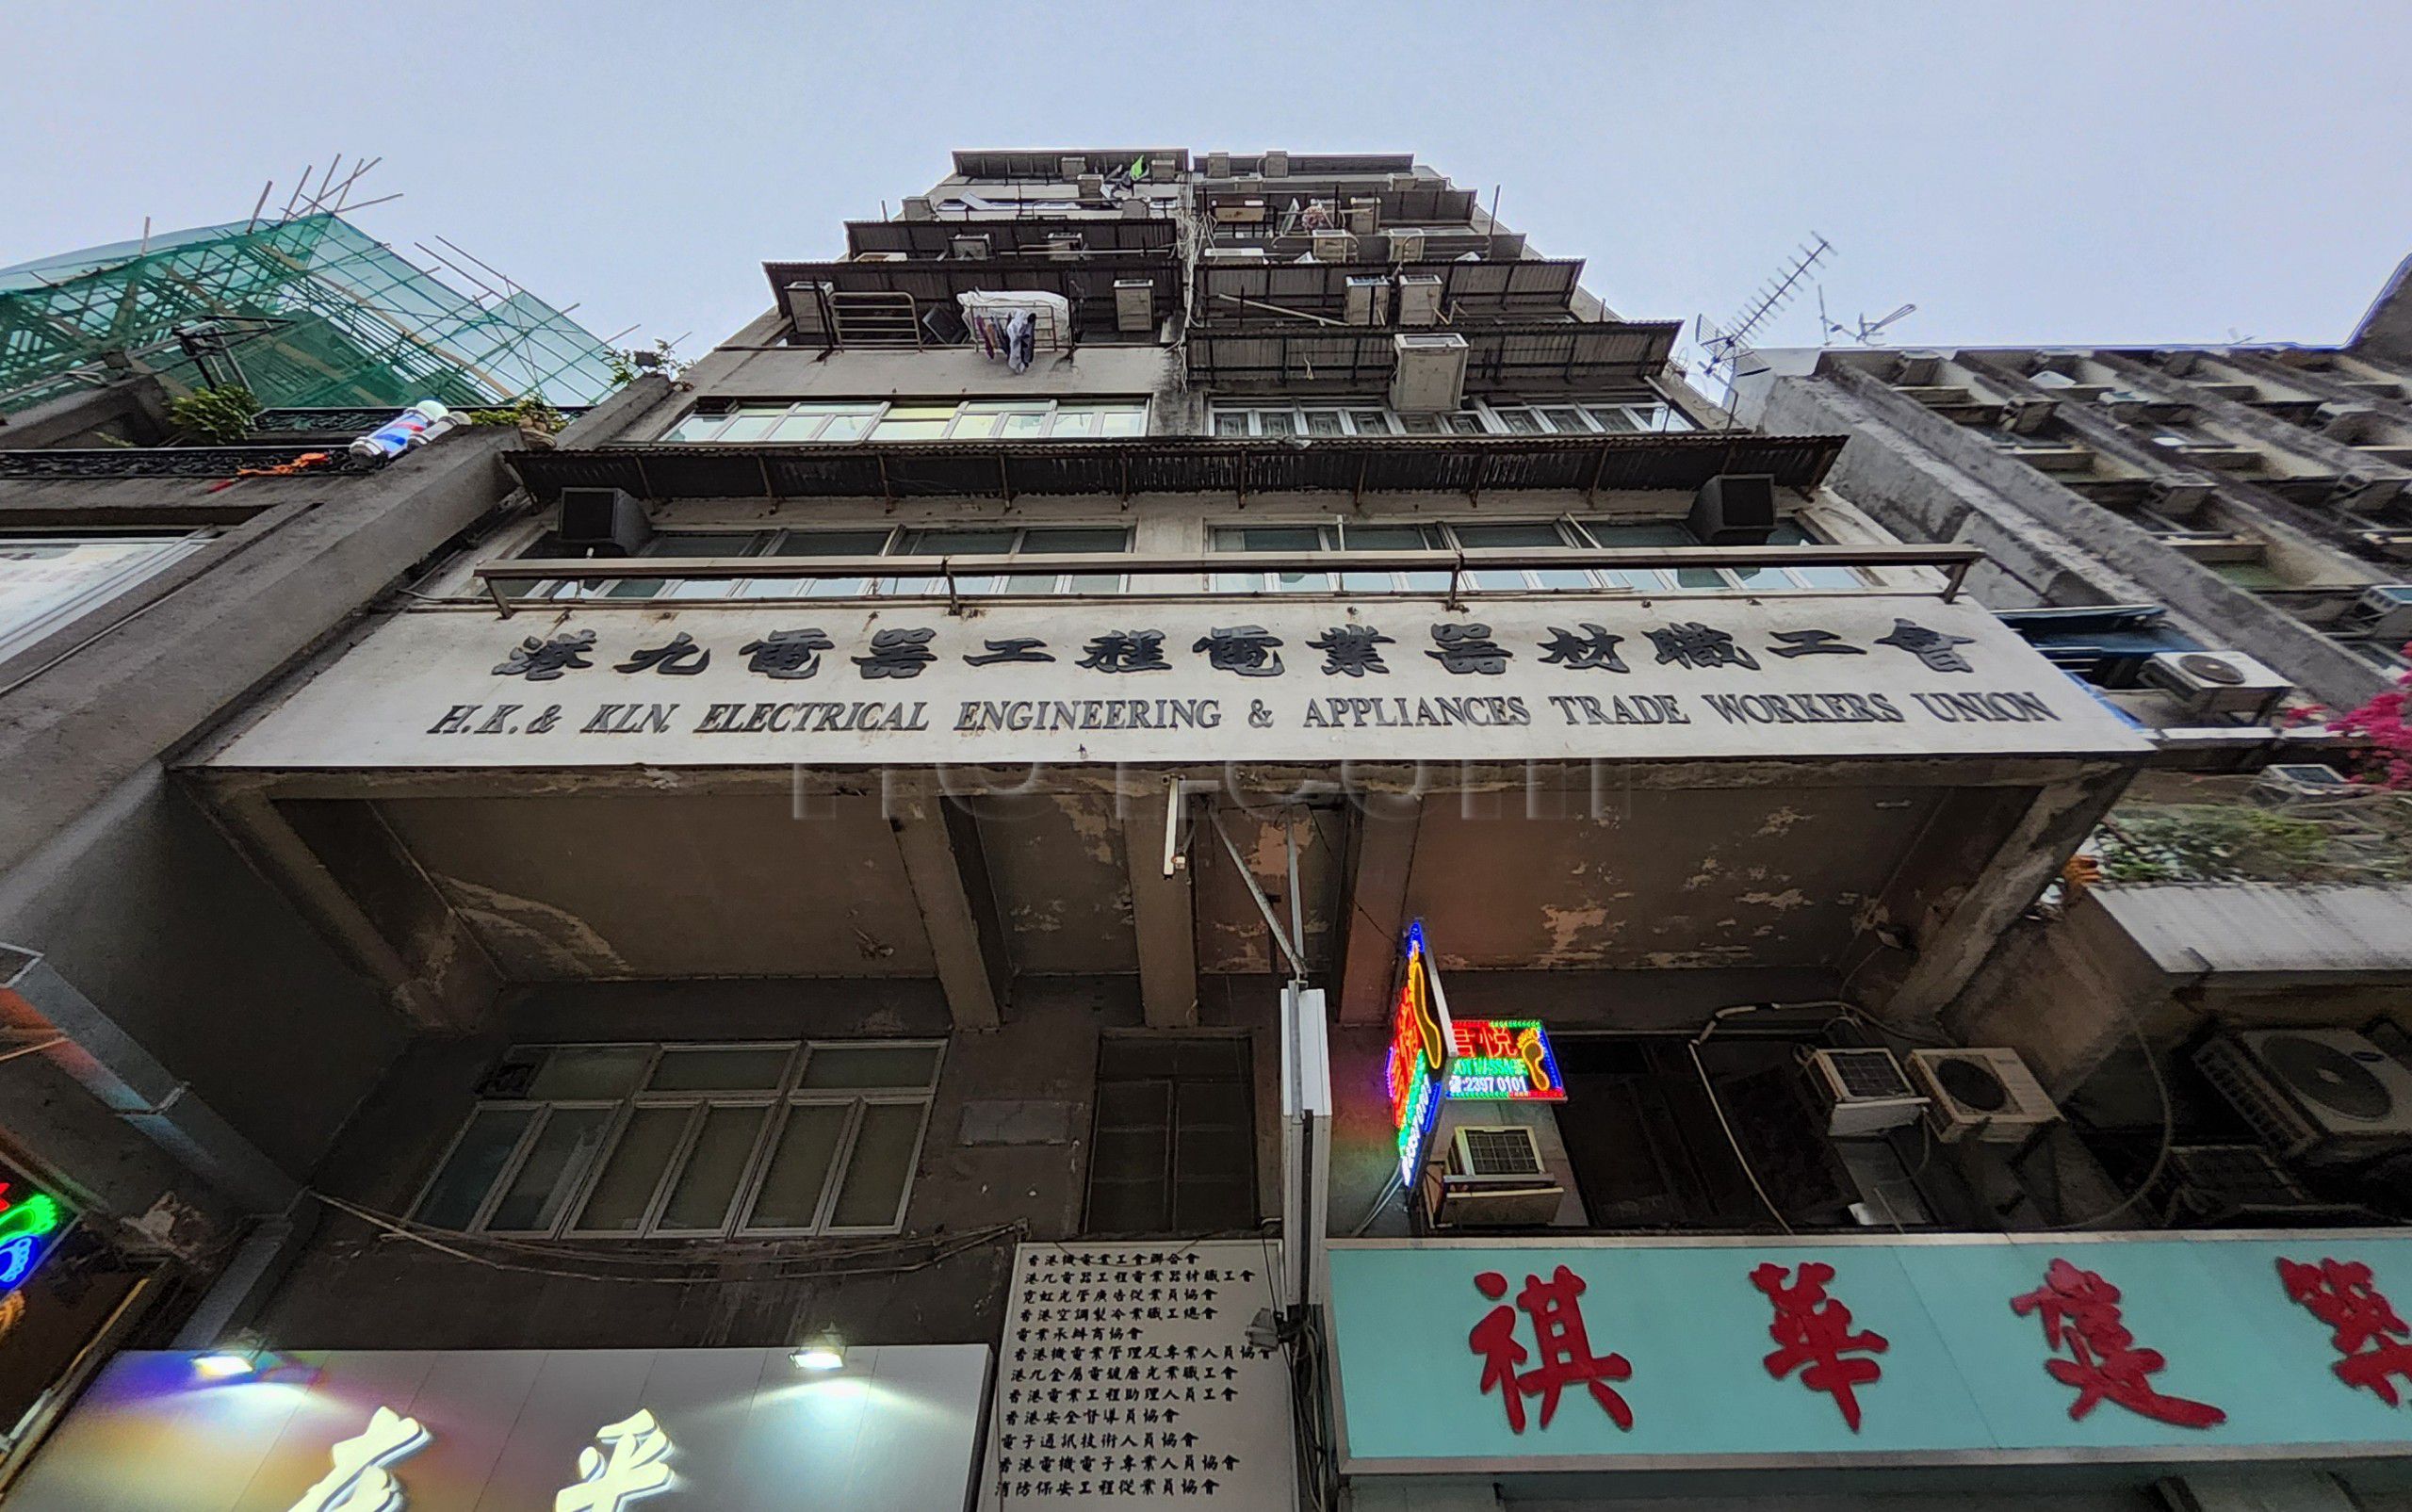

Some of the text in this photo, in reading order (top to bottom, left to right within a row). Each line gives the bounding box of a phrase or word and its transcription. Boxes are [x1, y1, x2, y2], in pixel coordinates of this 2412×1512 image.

[492, 617, 1977, 681] 港九電器工程電業器材職工會
[693, 701, 930, 734] ELECTRICAL
[953, 699, 1222, 732] ENGINEERING
[1247, 698, 1274, 729] &
[1303, 695, 1532, 728] APPLIANCES
[1548, 694, 1692, 726] TRADE
[1701, 692, 1906, 724] WORKERS
[1911, 691, 2062, 723] UNION
